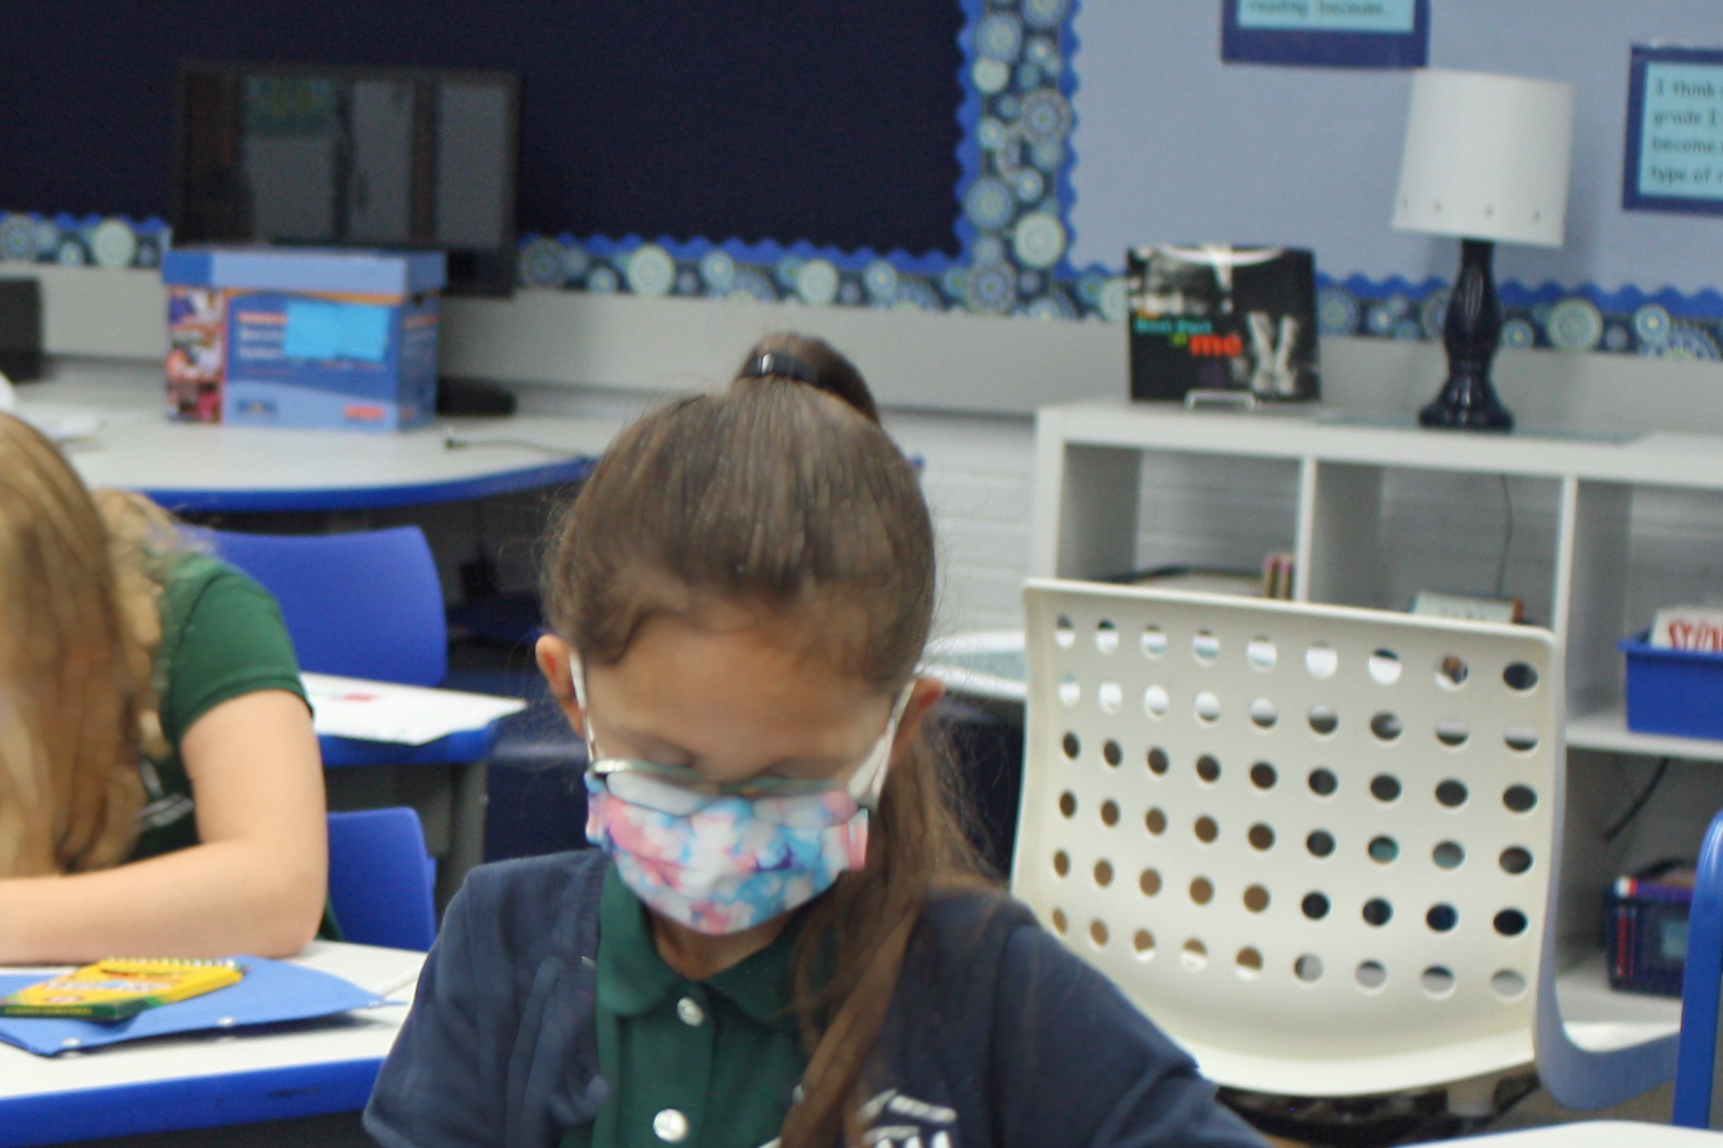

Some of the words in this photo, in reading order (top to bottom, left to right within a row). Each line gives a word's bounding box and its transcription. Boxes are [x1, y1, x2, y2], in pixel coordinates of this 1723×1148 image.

[1673, 80, 1715, 97] think
[1653, 110, 1702, 127] grade
[1651, 136, 1715, 154] become
[1650, 164, 1686, 184] type
[1693, 167, 1711, 183] of
[1188, 333, 1244, 358] me
